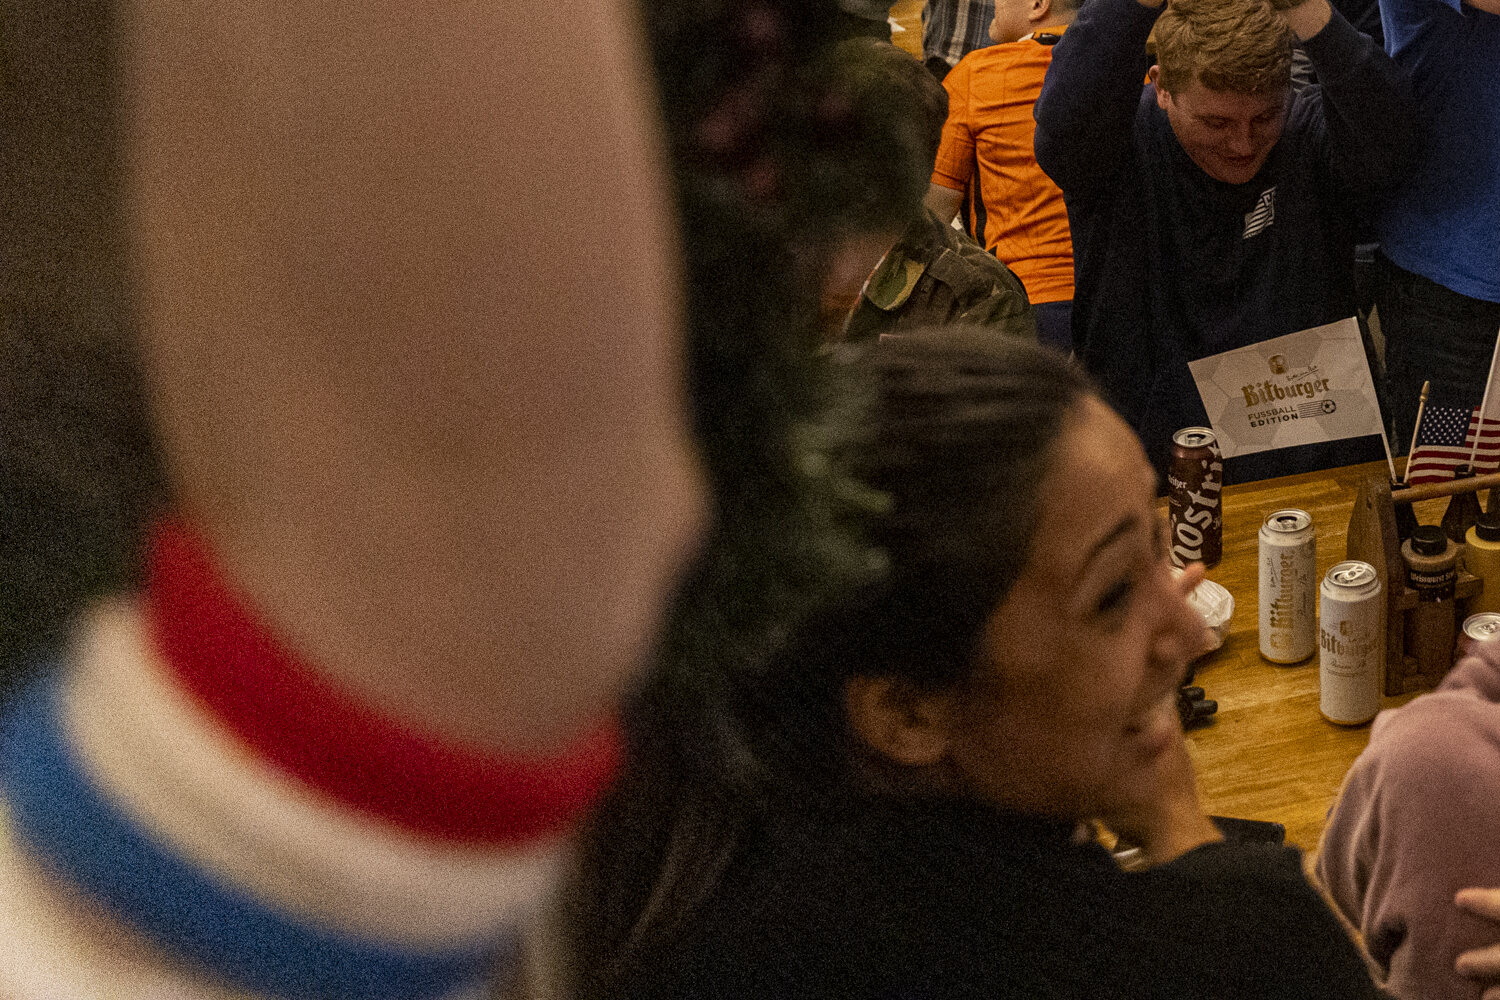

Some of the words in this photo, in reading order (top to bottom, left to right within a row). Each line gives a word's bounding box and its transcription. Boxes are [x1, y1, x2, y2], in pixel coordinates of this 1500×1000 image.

[1241, 378, 1330, 408] Bitburger
[1247, 405, 1297, 421] FUSSBALL
[1250, 413, 1299, 428] EDITION
[1270, 550, 1295, 629] Bitburger
